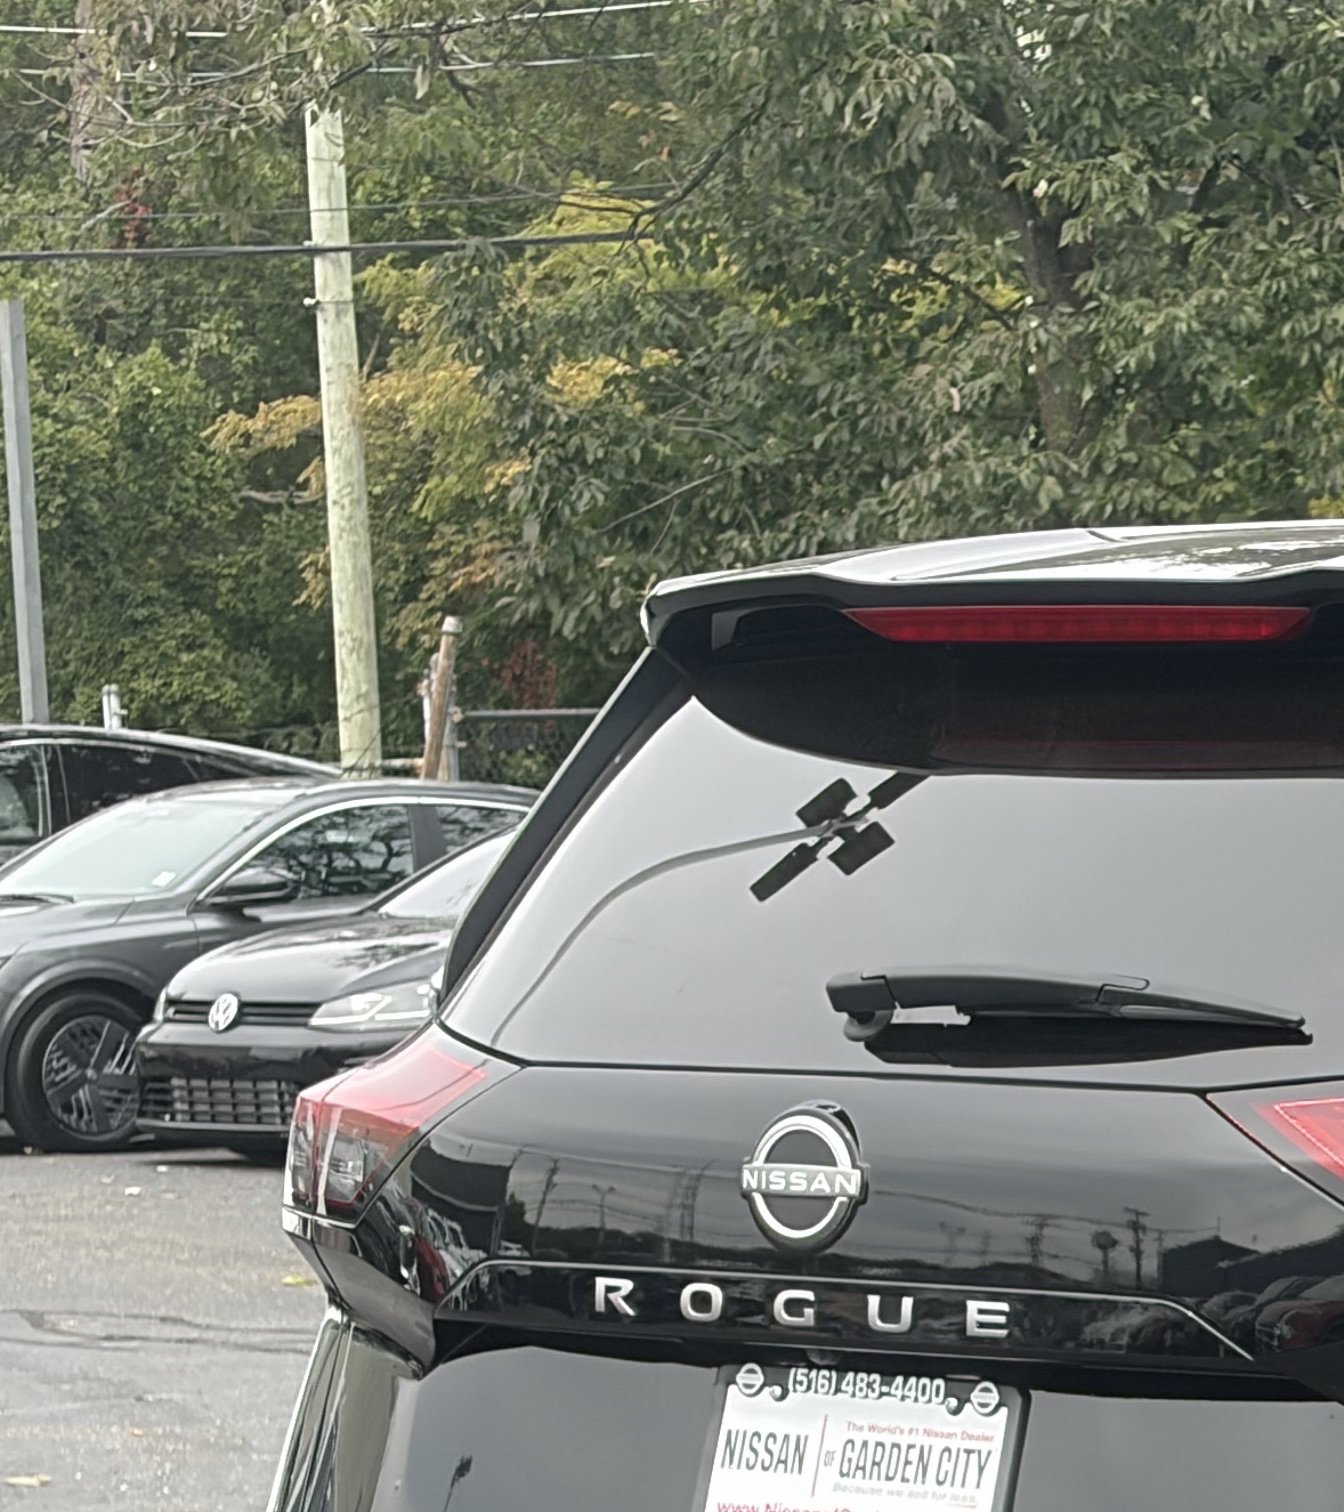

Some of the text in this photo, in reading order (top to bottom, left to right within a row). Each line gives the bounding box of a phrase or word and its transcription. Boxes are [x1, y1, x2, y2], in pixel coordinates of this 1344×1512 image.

[742, 1166, 860, 1196] NISSAN
[594, 1276, 1011, 1339] ROGUE
[788, 1366, 946, 1405] (516) 483-4400
[846, 1420, 865, 1433] The
[922, 1427, 958, 1441] Nissan
[960, 1430, 995, 1443] Dealer
[720, 1428, 808, 1475] NISSAN
[838, 1438, 933, 1486] GARDEN
[935, 1445, 993, 1490] CITY
